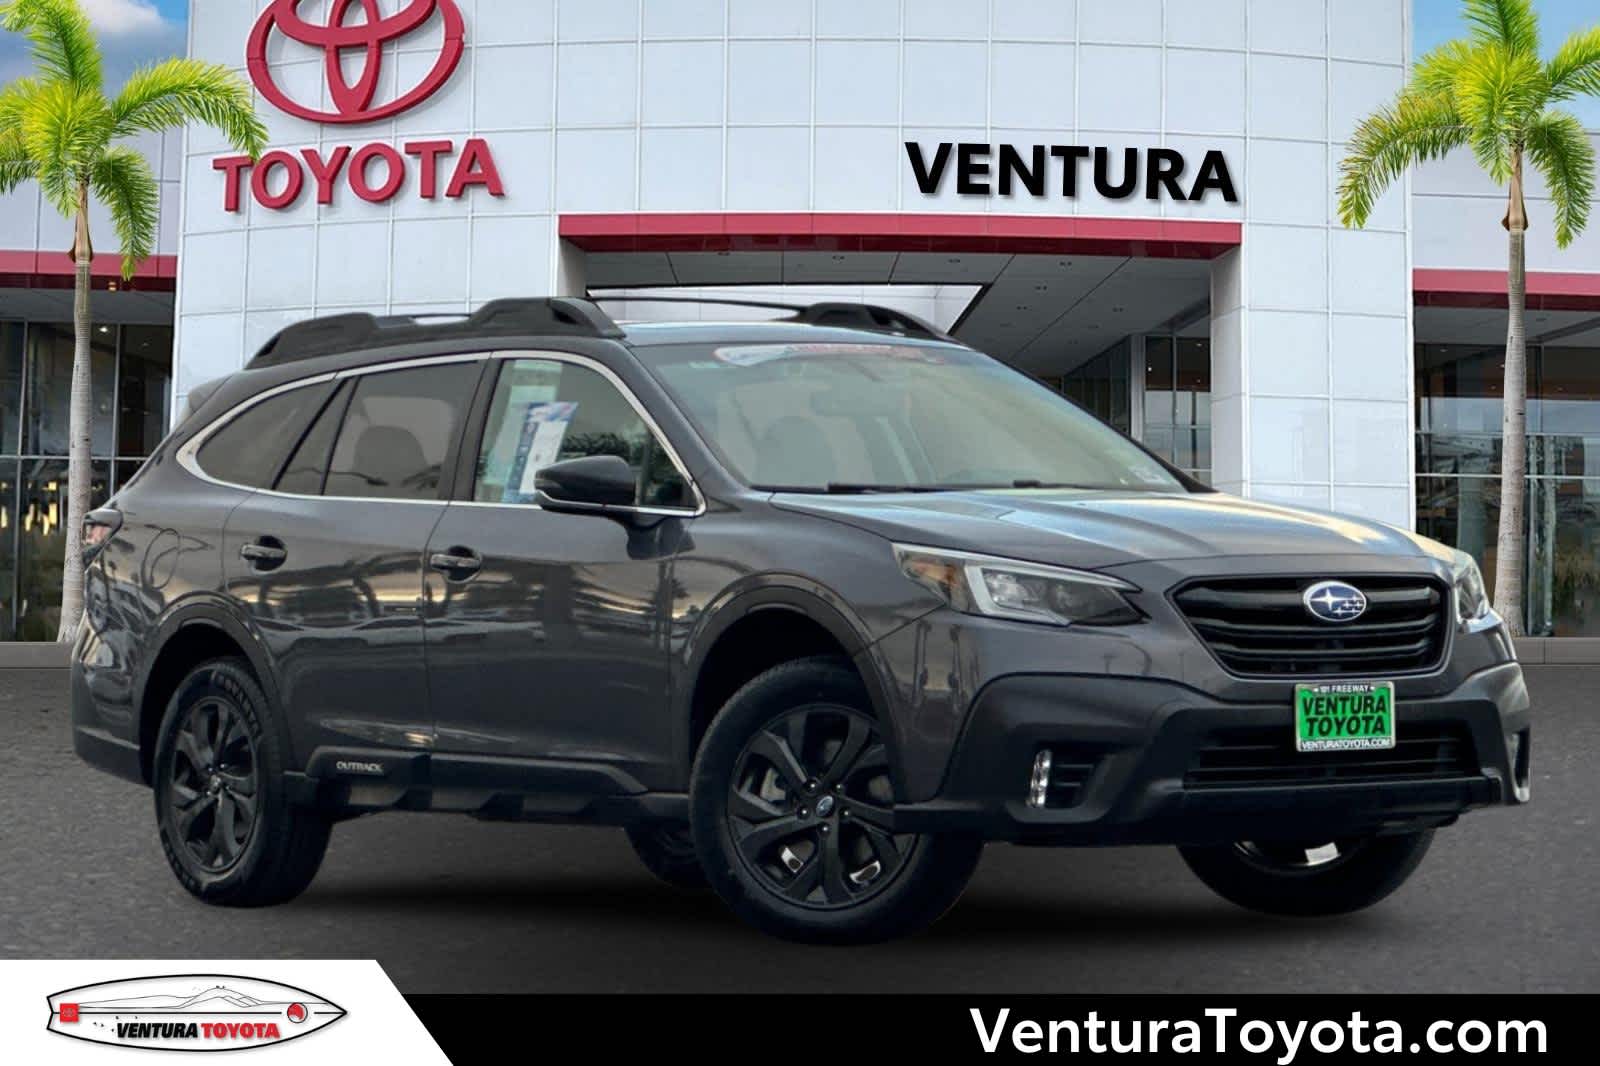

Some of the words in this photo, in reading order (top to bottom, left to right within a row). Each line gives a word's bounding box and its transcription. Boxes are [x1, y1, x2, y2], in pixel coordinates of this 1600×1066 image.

[213, 139, 504, 212] TOYOTA
[905, 142, 1238, 203] VENTURA
[1332, 685, 1369, 693] FREEWAY
[1303, 696, 1387, 716] VENTURA
[1306, 716, 1386, 737] TOYOTA
[1302, 739, 1390, 750] VENTURATOYOTA.COM
[336, 760, 384, 773] OUTBACK
